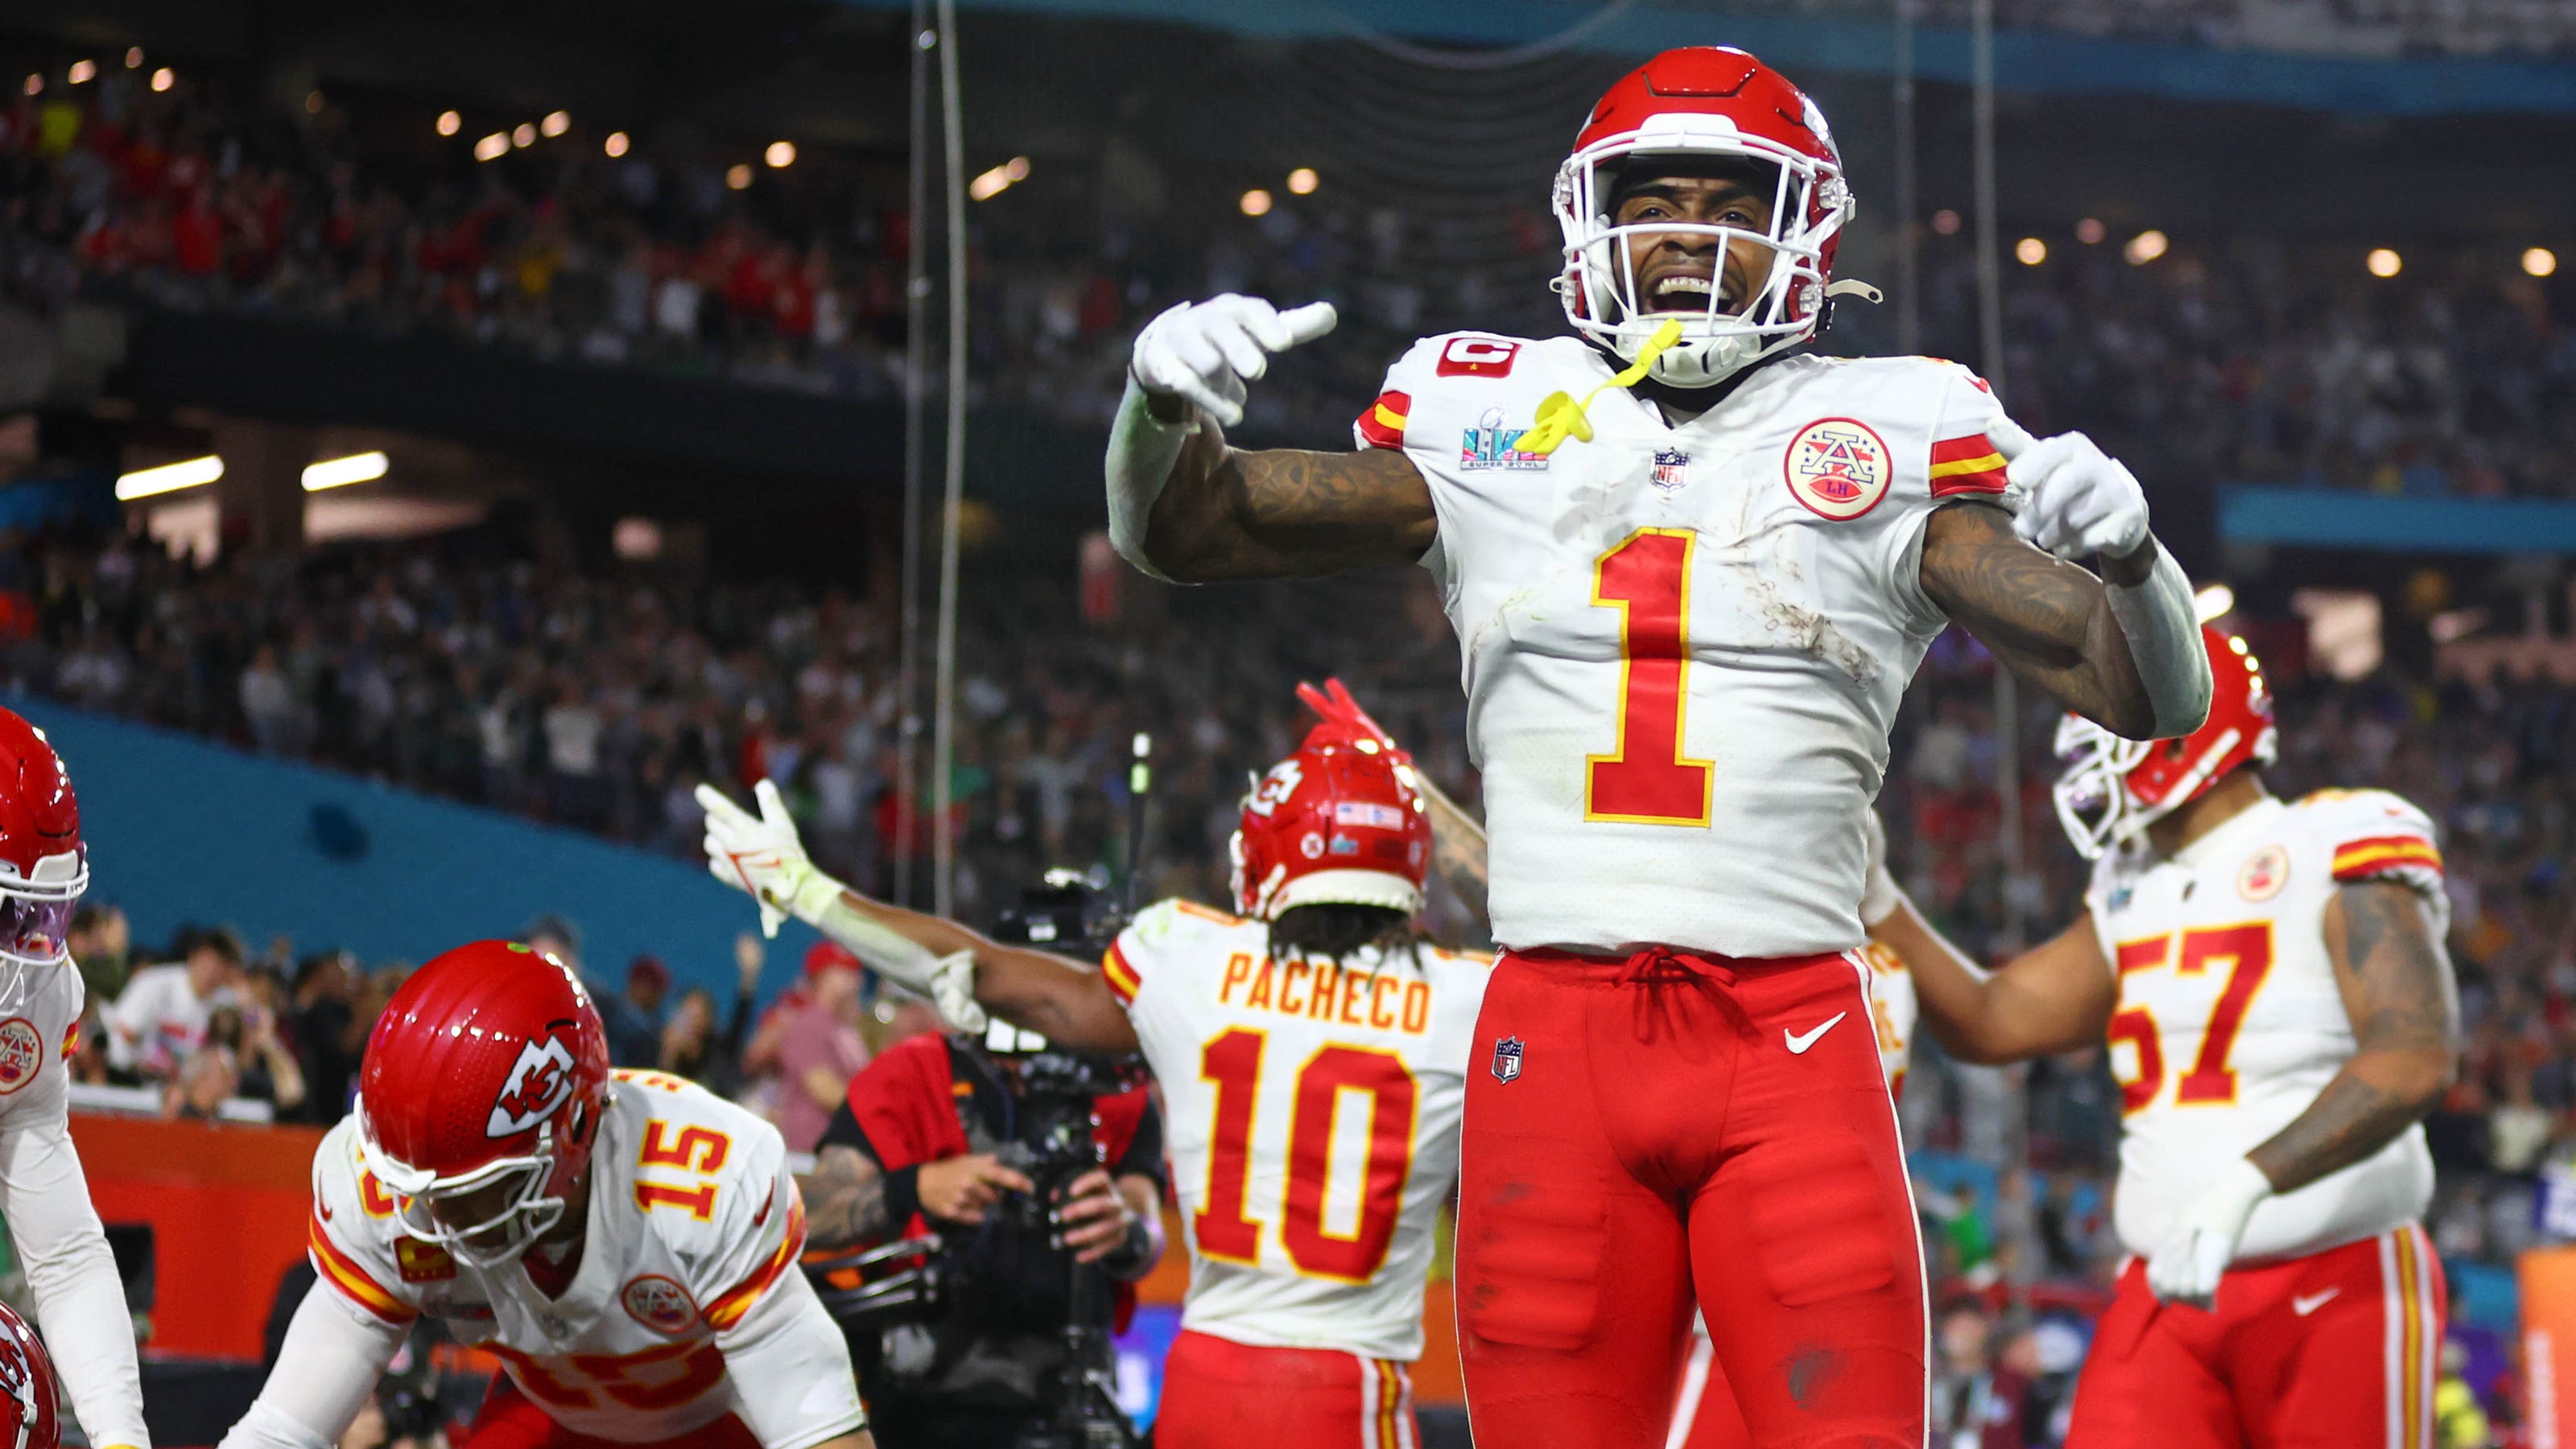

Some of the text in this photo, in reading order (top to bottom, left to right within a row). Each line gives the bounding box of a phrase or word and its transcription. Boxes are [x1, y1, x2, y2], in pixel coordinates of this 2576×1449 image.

[1446, 337, 1514, 364] C
[1463, 428, 1548, 460] LV
[1800, 430, 1874, 485] A
[1656, 465, 1680, 483] NFL
[1826, 481, 1848, 497] LH
[1583, 526, 1715, 829] 1
[1219, 952, 1431, 1035] PACHECO
[2107, 919, 2274, 1117] 57
[1496, 1055, 1517, 1074] NFL
[633, 1118, 731, 1224] 15
[1193, 1024, 1422, 1286] 10
